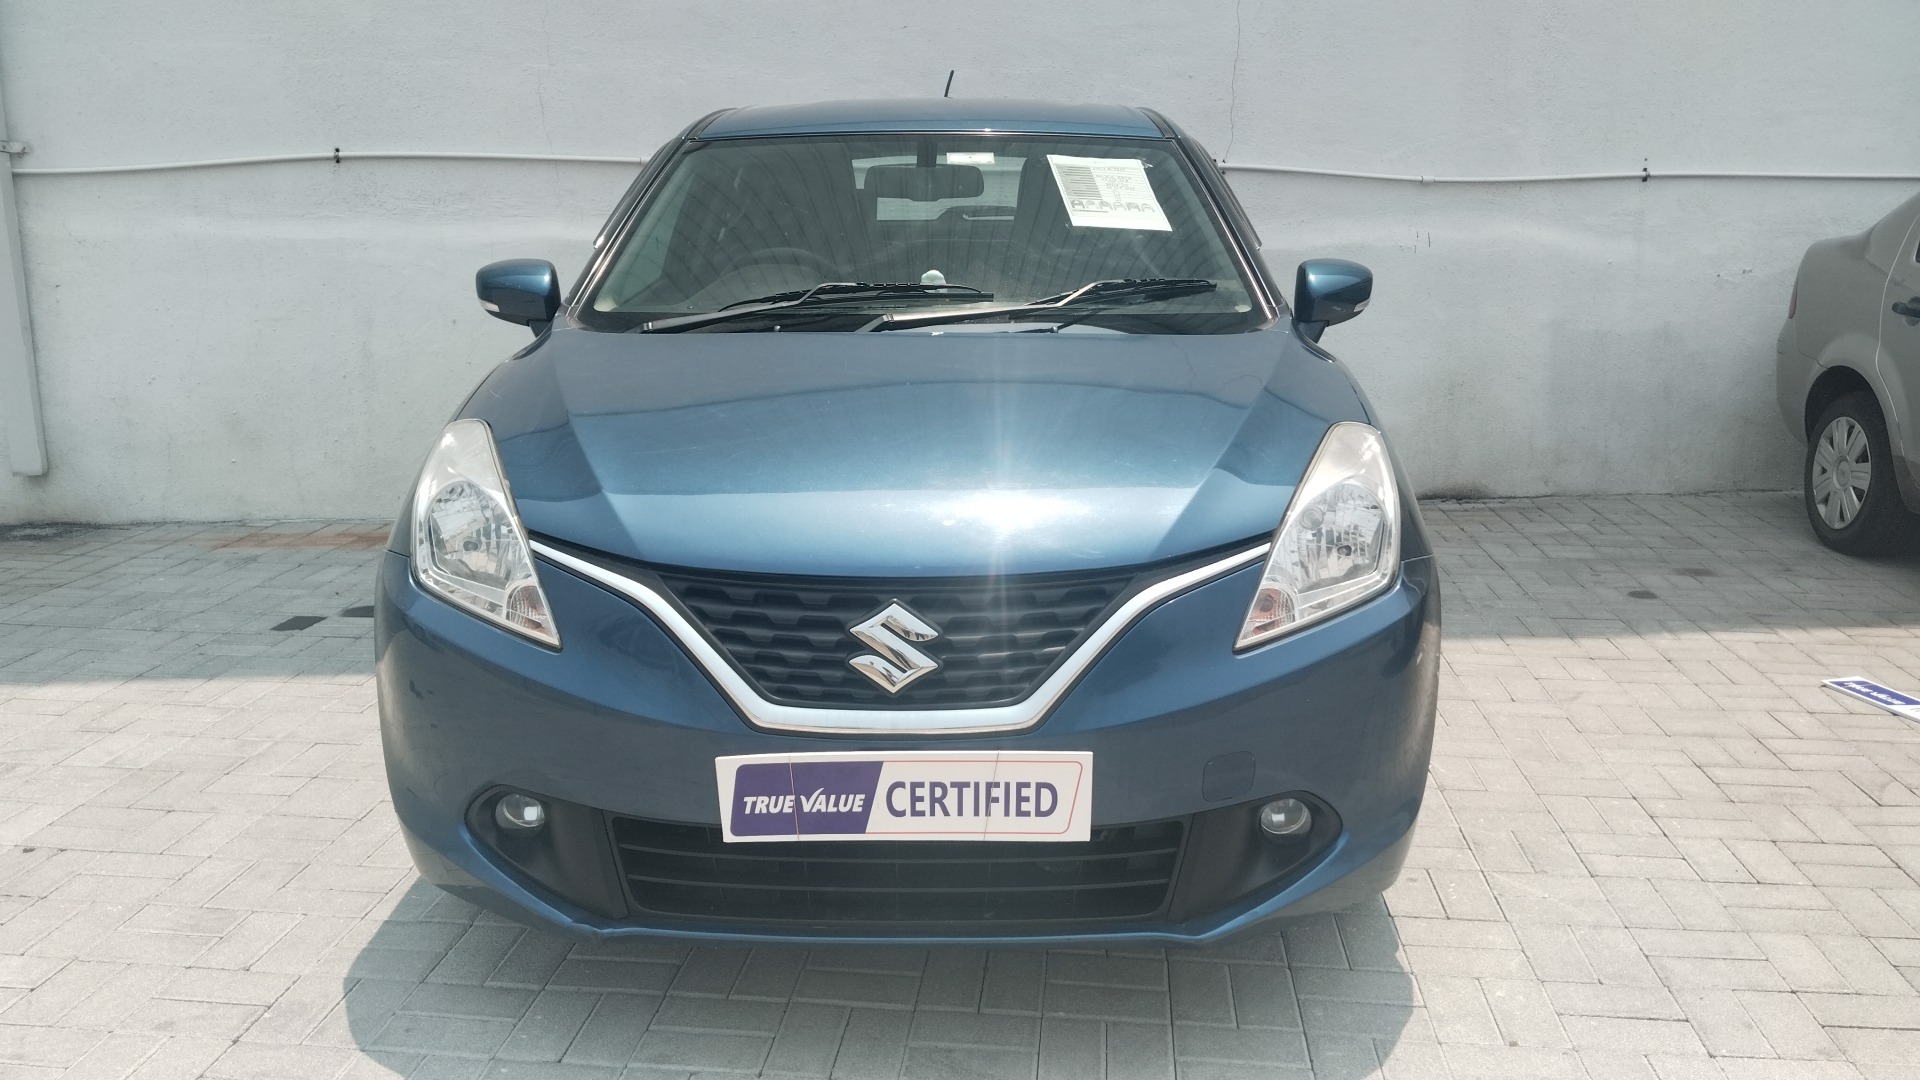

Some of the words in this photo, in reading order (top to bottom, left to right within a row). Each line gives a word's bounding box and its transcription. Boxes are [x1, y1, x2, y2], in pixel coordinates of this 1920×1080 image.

[743, 794, 795, 815] TRUE
[799, 788, 866, 814] VALUE
[885, 781, 1059, 818] CERTIFIED
